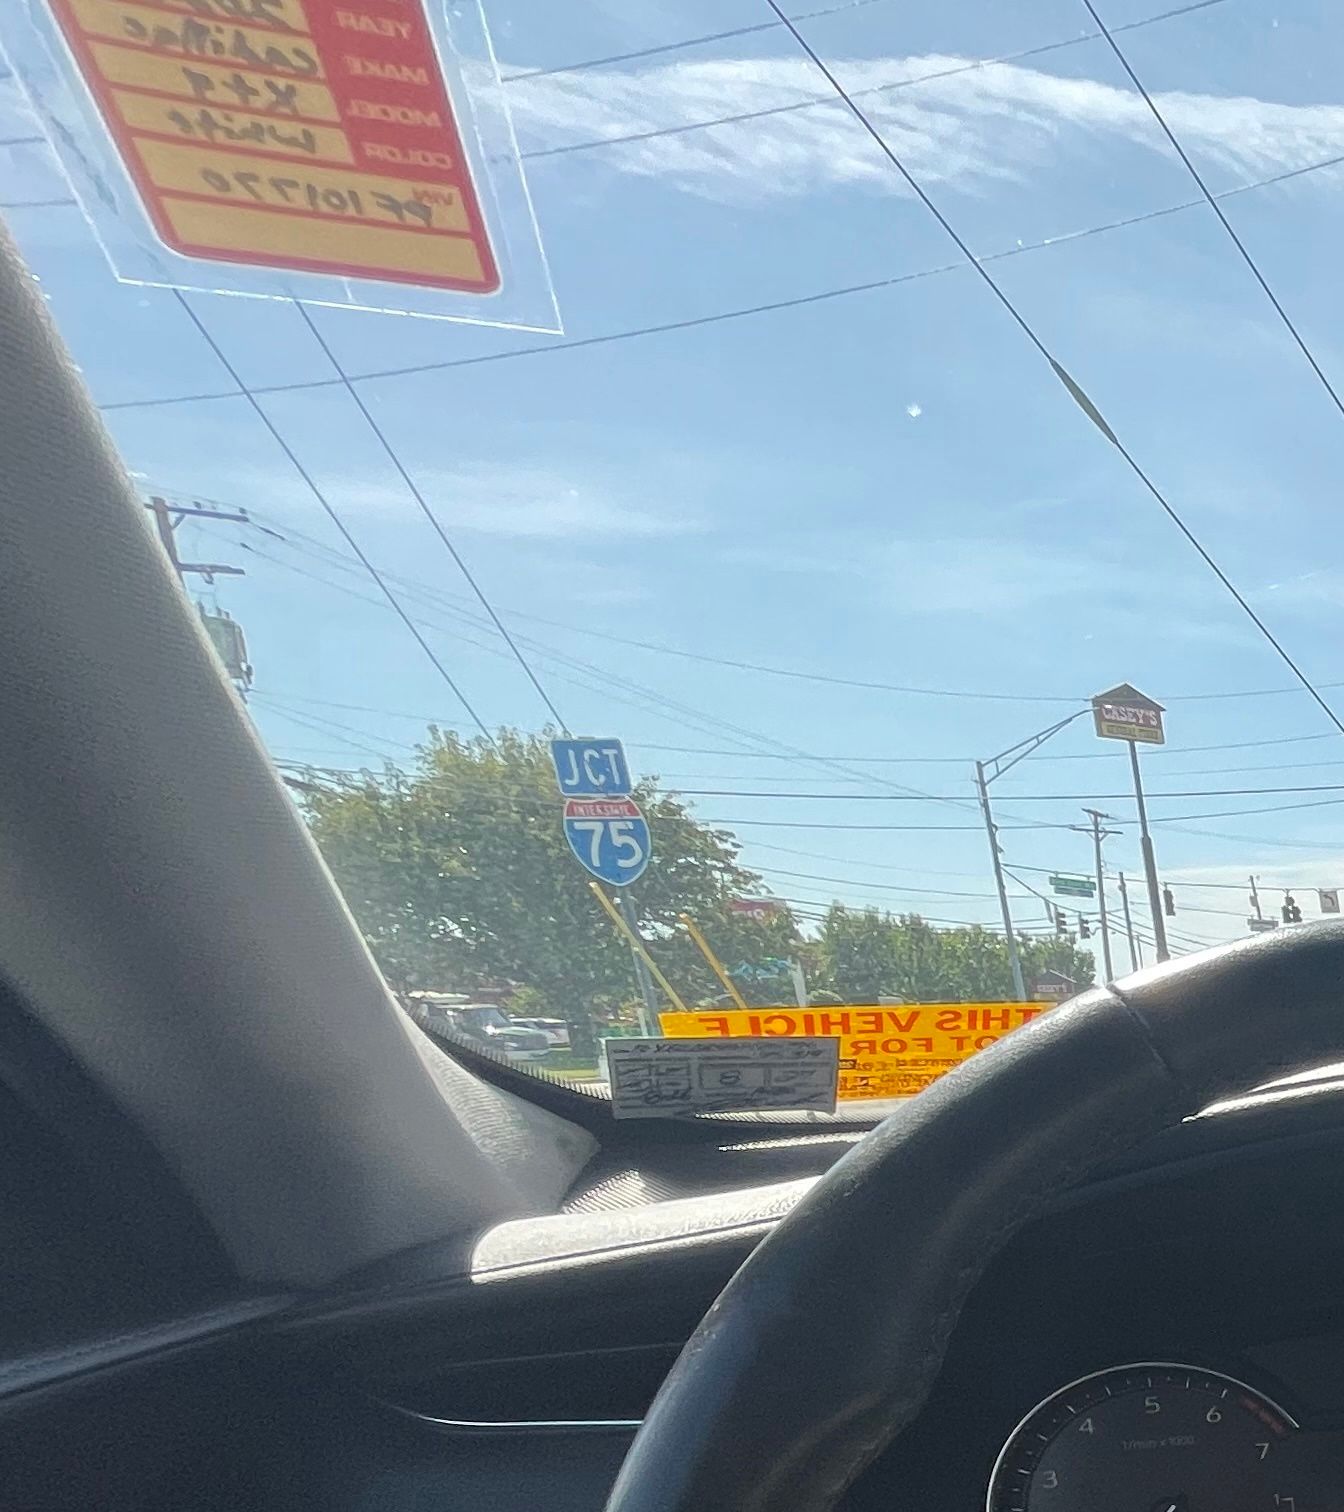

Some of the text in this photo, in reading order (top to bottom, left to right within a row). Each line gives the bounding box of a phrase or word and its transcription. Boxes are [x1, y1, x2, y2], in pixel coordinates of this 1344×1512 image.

[1102, 704, 1158, 726] CASEY'S
[565, 749, 622, 786] JCT
[573, 821, 643, 868] 75
[1144, 1396, 1161, 1414] 5
[1206, 1406, 1222, 1423] 6
[1078, 1417, 1095, 1435] 4
[1255, 1442, 1271, 1459] 7
[1042, 1470, 1059, 1489] 3
